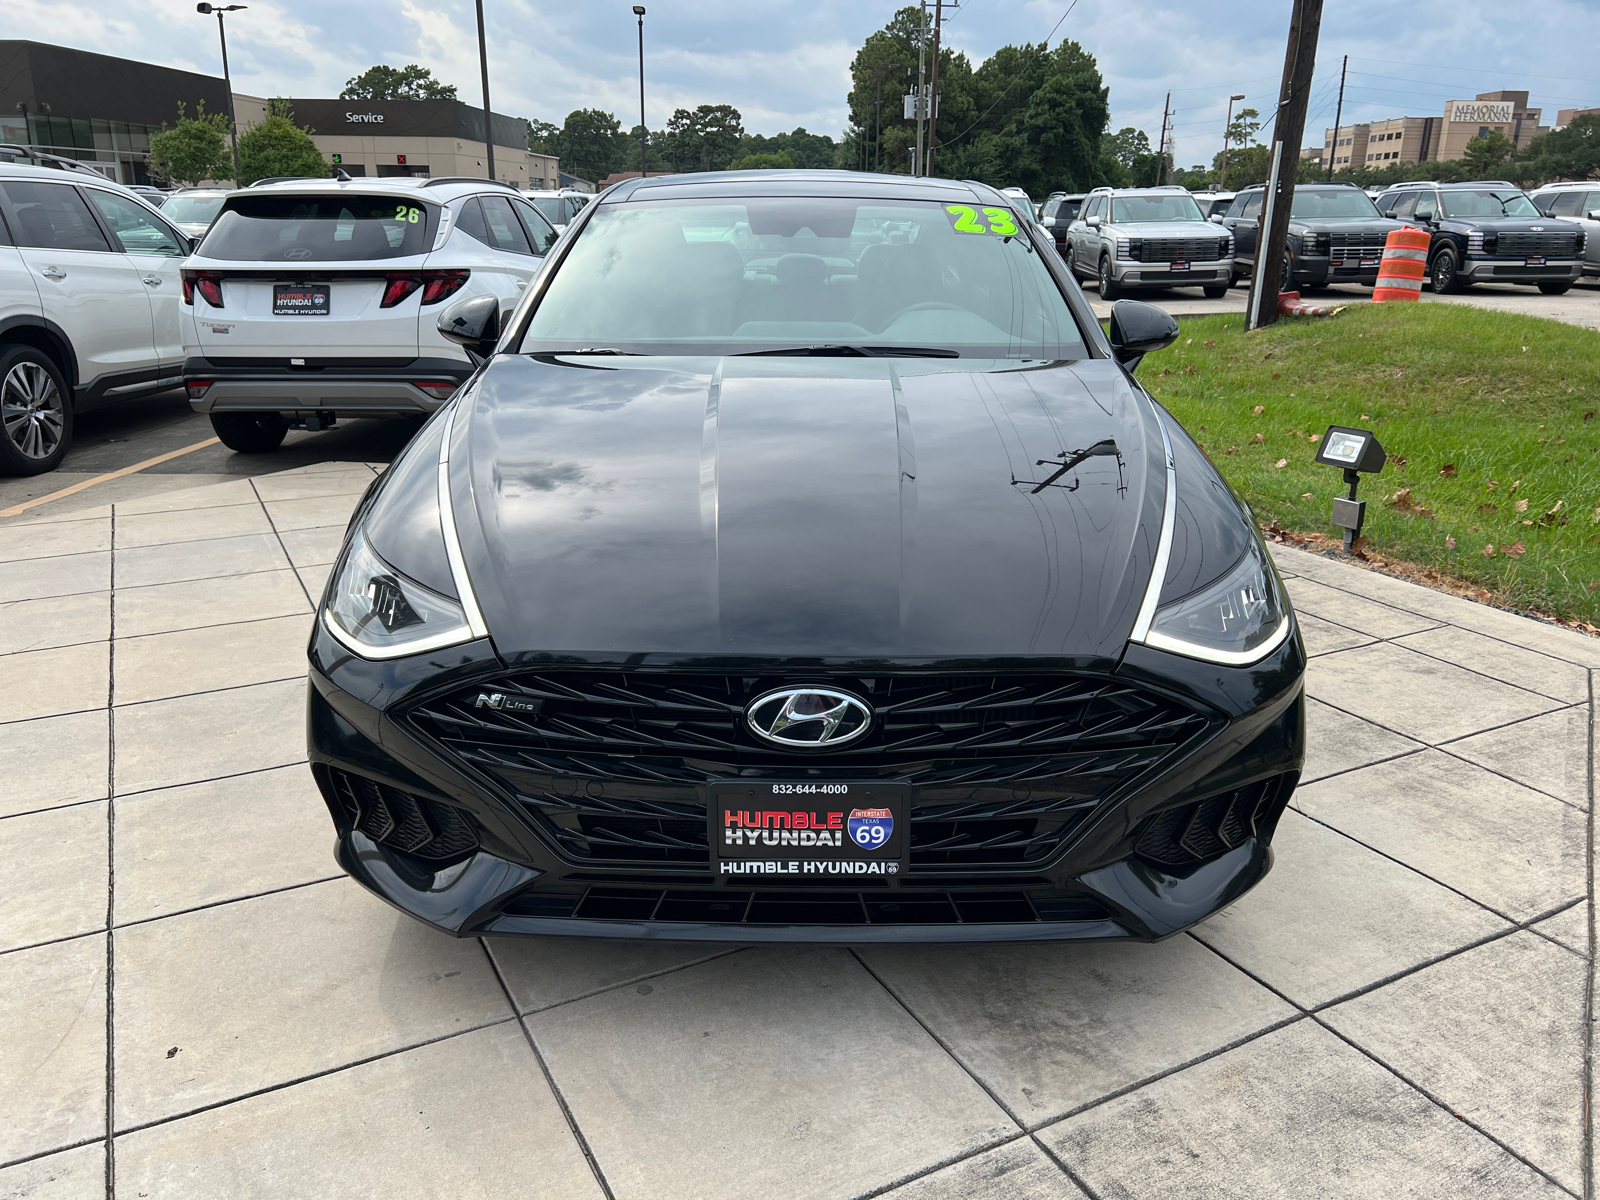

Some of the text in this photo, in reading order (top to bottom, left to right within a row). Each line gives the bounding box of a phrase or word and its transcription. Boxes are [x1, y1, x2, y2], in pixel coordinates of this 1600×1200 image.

[1455, 103, 1511, 115] MEMORIAL
[345, 112, 384, 123] Service
[1454, 112, 1511, 122] HERMANN
[395, 205, 420, 224] 26
[946, 205, 1019, 236] 23
[505, 700, 534, 711] Line
[772, 784, 848, 795] 832-644-4000
[724, 809, 844, 829] HUMBLE
[724, 828, 843, 847] HYUNDAI
[856, 825, 886, 844] 69
[720, 861, 800, 874] HUMBLE
[803, 861, 886, 874] HYUNDAI
